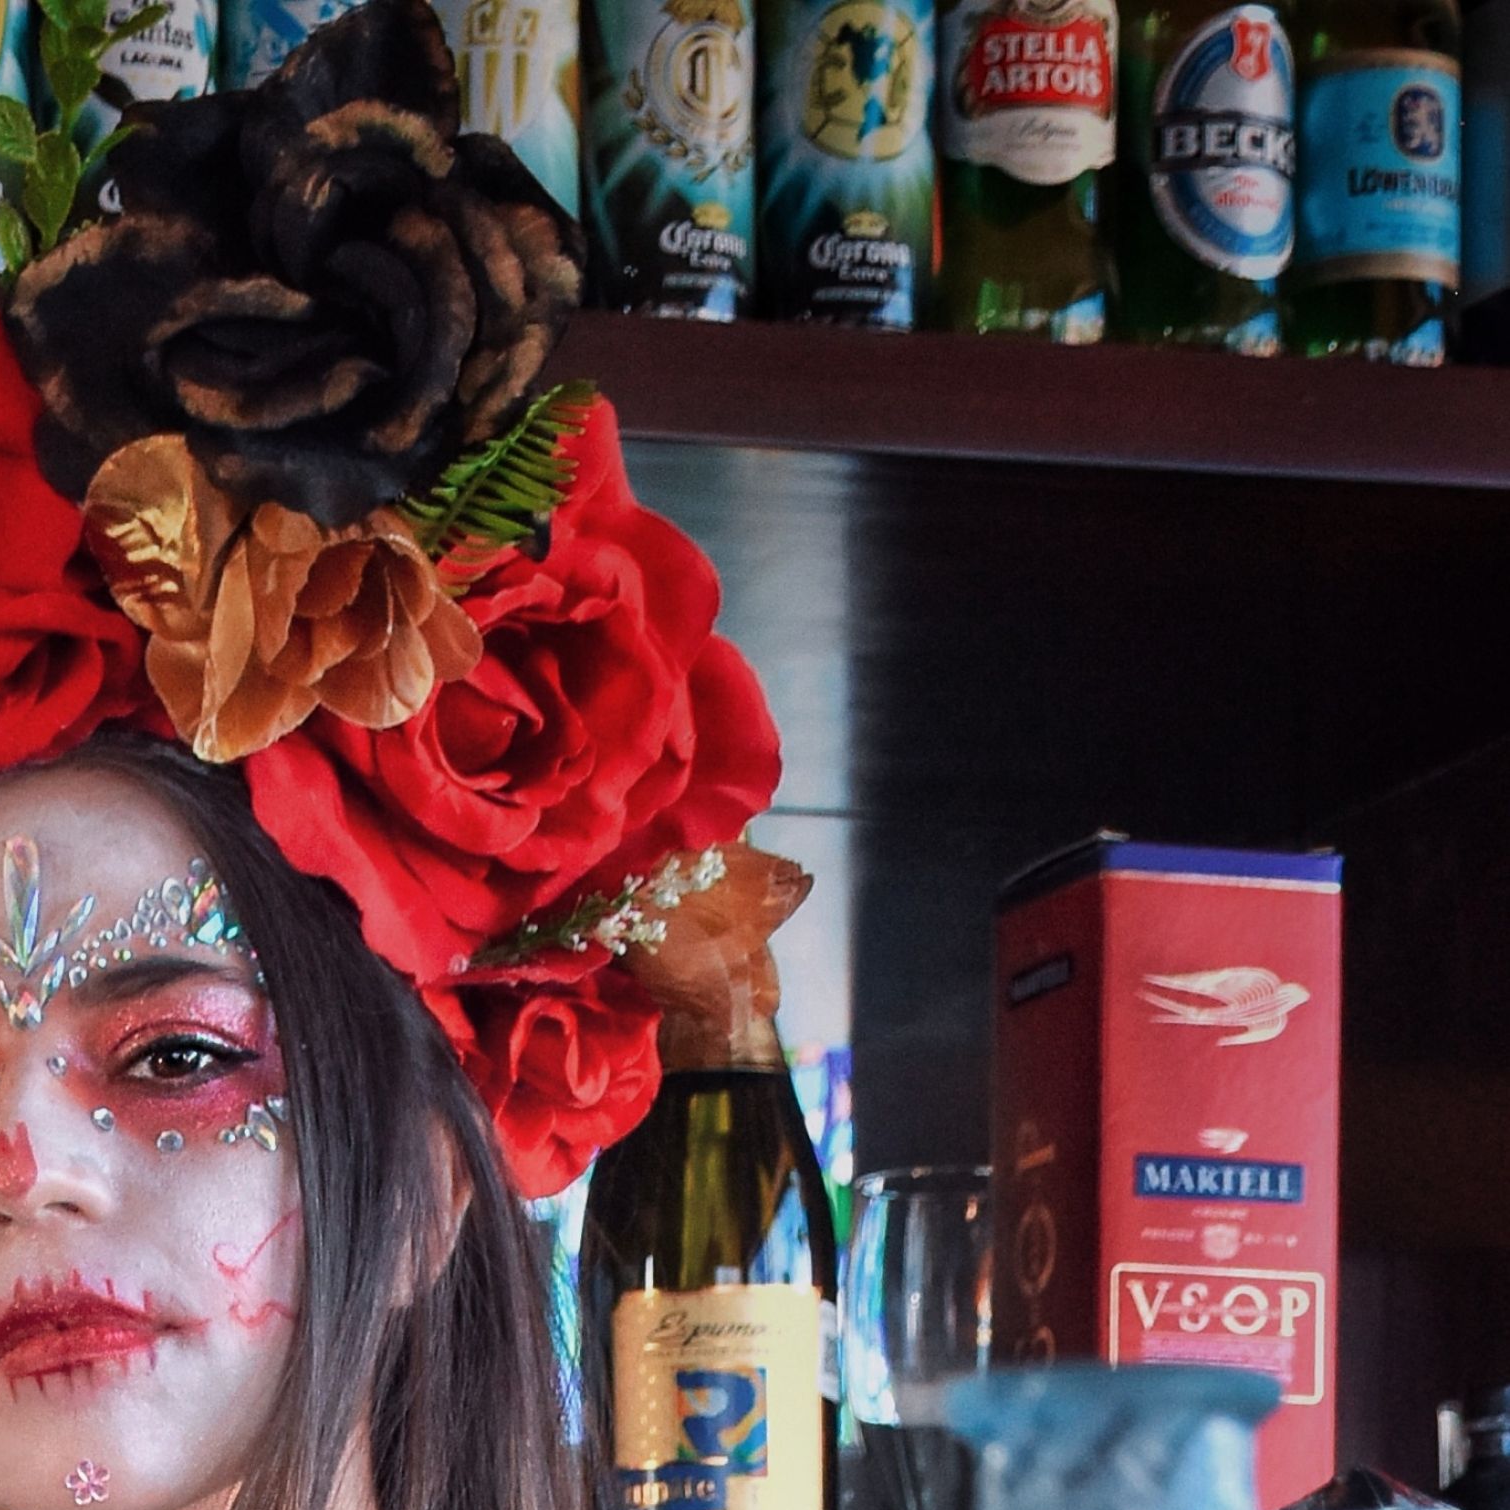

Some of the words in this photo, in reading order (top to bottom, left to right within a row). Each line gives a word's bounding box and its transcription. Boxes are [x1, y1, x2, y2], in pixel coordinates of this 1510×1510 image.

[982, 32, 1100, 65] STELLA
[980, 62, 1103, 98] ARTOIS
[658, 219, 747, 259] Corona
[808, 234, 910, 270] Corona
[1143, 1162, 1296, 1199] MARTELL
[1125, 1278, 1311, 1337] VSOP
